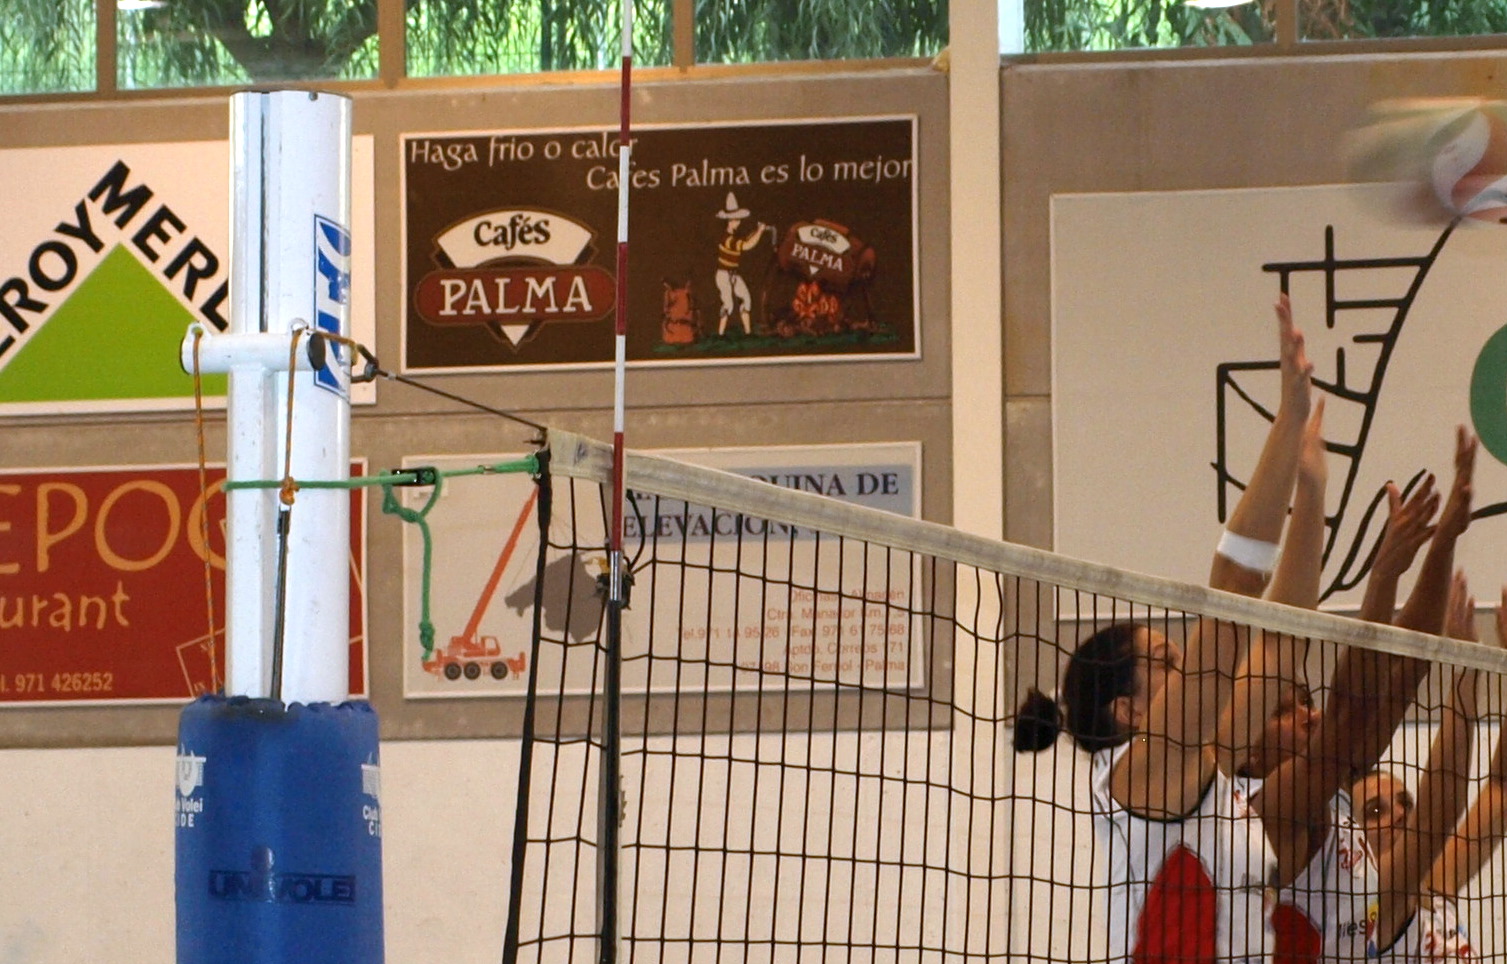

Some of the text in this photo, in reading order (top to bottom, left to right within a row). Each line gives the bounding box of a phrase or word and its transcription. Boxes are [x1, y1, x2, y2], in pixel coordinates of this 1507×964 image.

[411, 140, 478, 171] Haga
[544, 142, 561, 160] o
[671, 158, 750, 187] Palma
[760, 163, 789, 184] es
[799, 154, 823, 182] lo
[833, 154, 912, 184] mejor
[474, 215, 551, 251] Cafés
[791, 243, 844, 272] PALMA
[439, 276, 593, 317] PALMA
[857, 473, 899, 495] DE
[14, 673, 45, 692] 971
[51, 672, 113, 692] 426252
